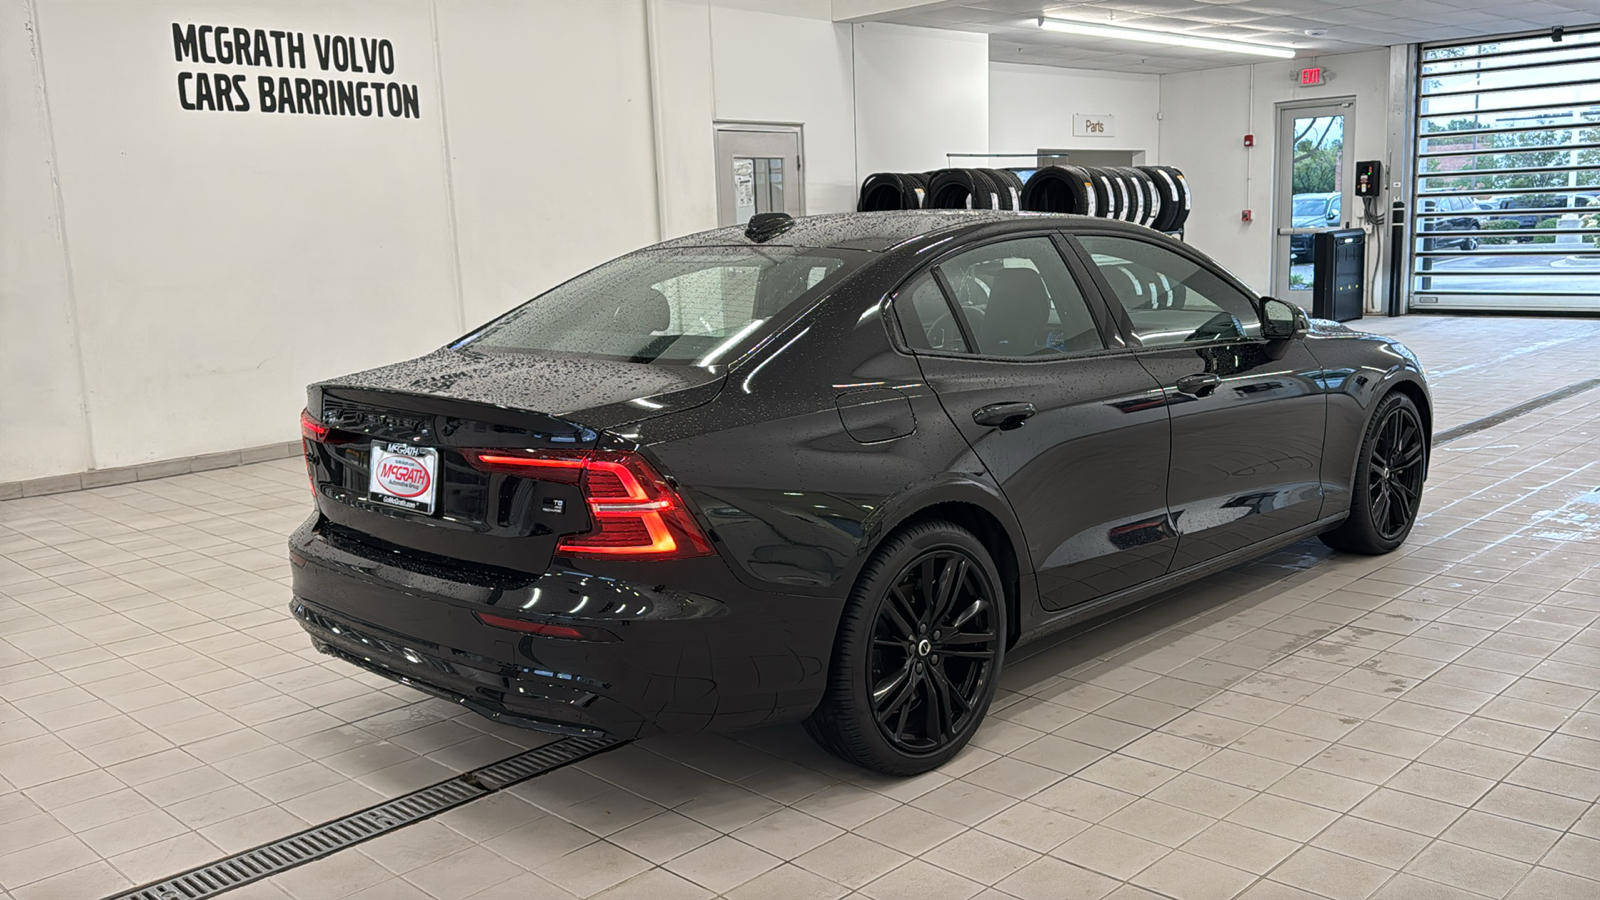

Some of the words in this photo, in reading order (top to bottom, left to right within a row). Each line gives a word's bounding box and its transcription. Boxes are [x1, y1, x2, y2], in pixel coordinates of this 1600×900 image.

[172, 23, 306, 69] MCGRATH
[313, 33, 394, 74] VOLVO
[1302, 68, 1320, 84] EXIT
[178, 72, 250, 112] CARS
[258, 75, 420, 118] BARRINGTON
[1086, 120, 1104, 133] Parts
[388, 479, 408, 487] Automotive
